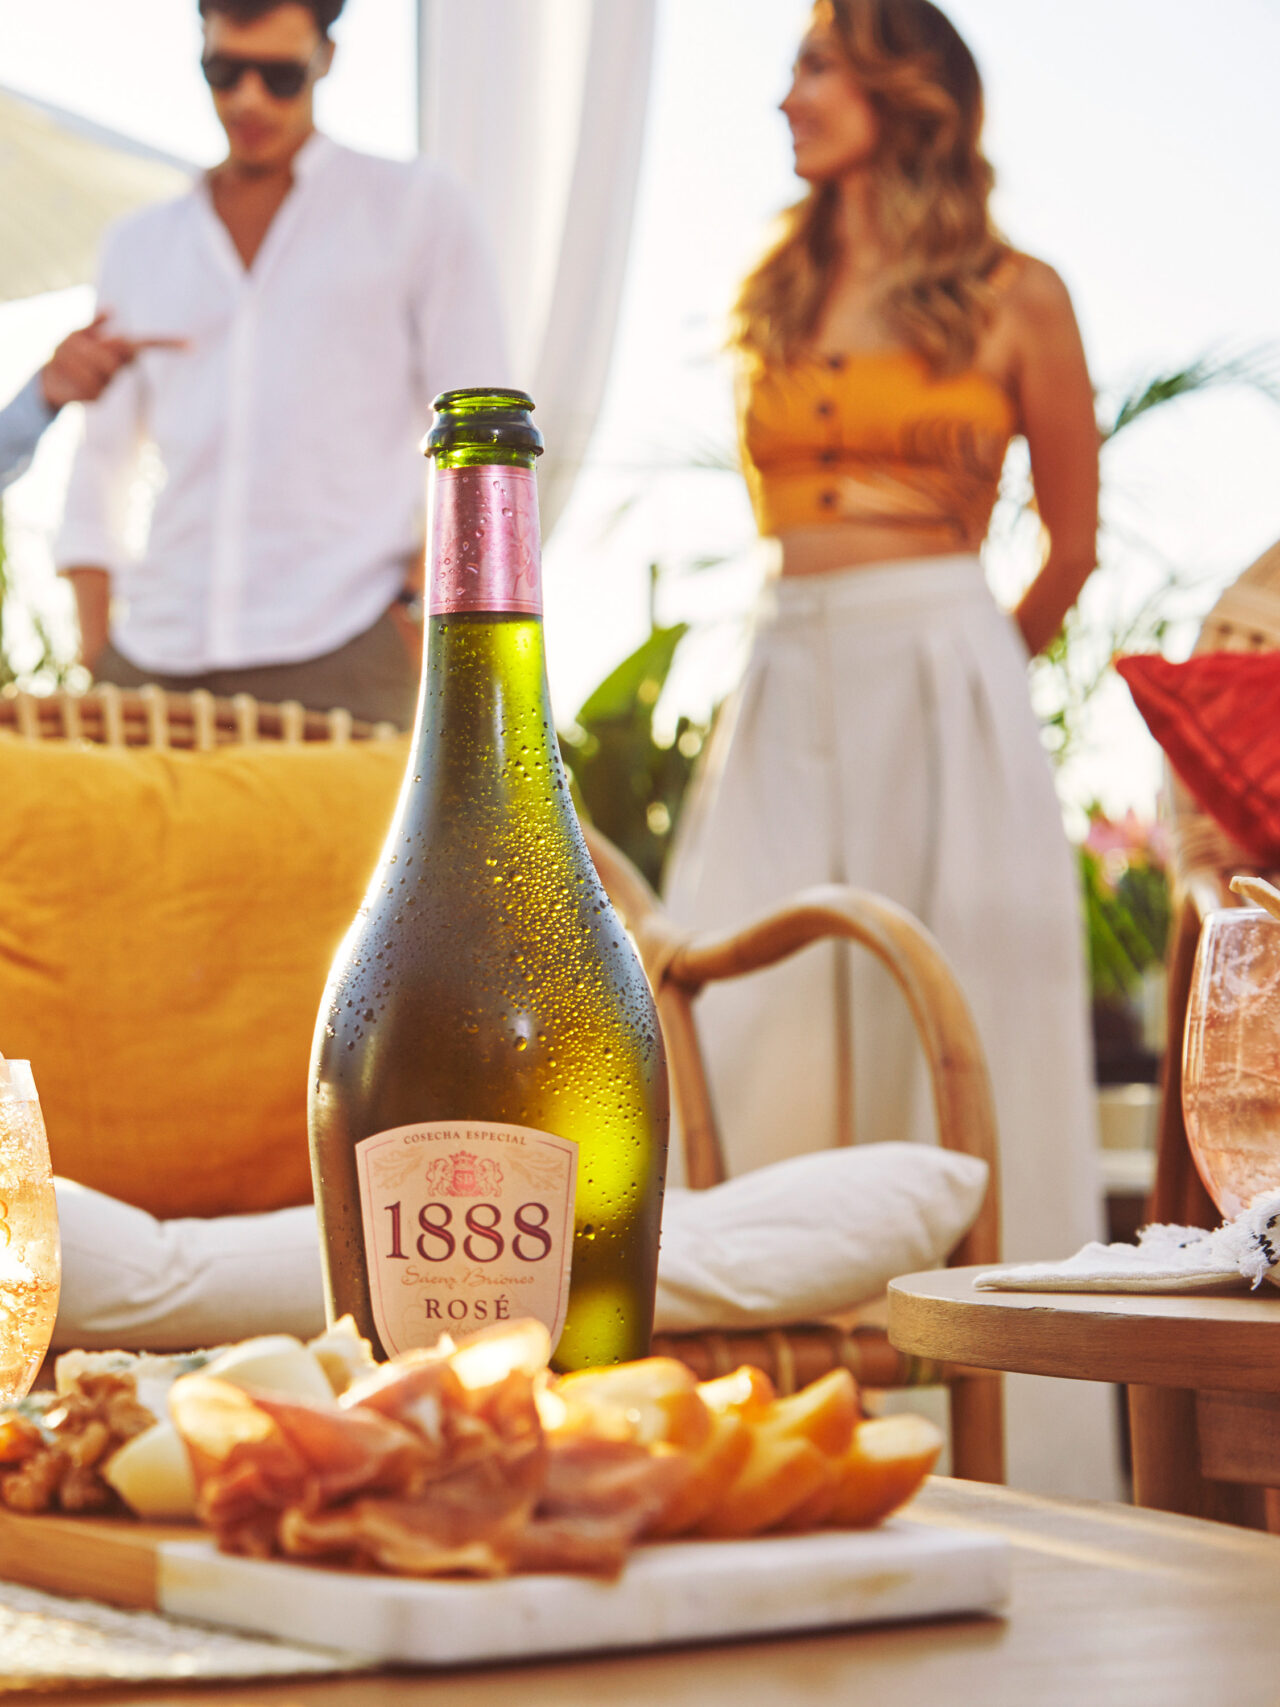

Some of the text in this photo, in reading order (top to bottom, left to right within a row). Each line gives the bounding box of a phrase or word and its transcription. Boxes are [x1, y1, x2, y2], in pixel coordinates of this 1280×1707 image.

[403, 1130, 527, 1146] COSECHA ESPECIAL
[384, 1200, 553, 1263] 1888
[461, 1266, 535, 1288] Briones
[424, 1294, 511, 1321] ROSÉ
